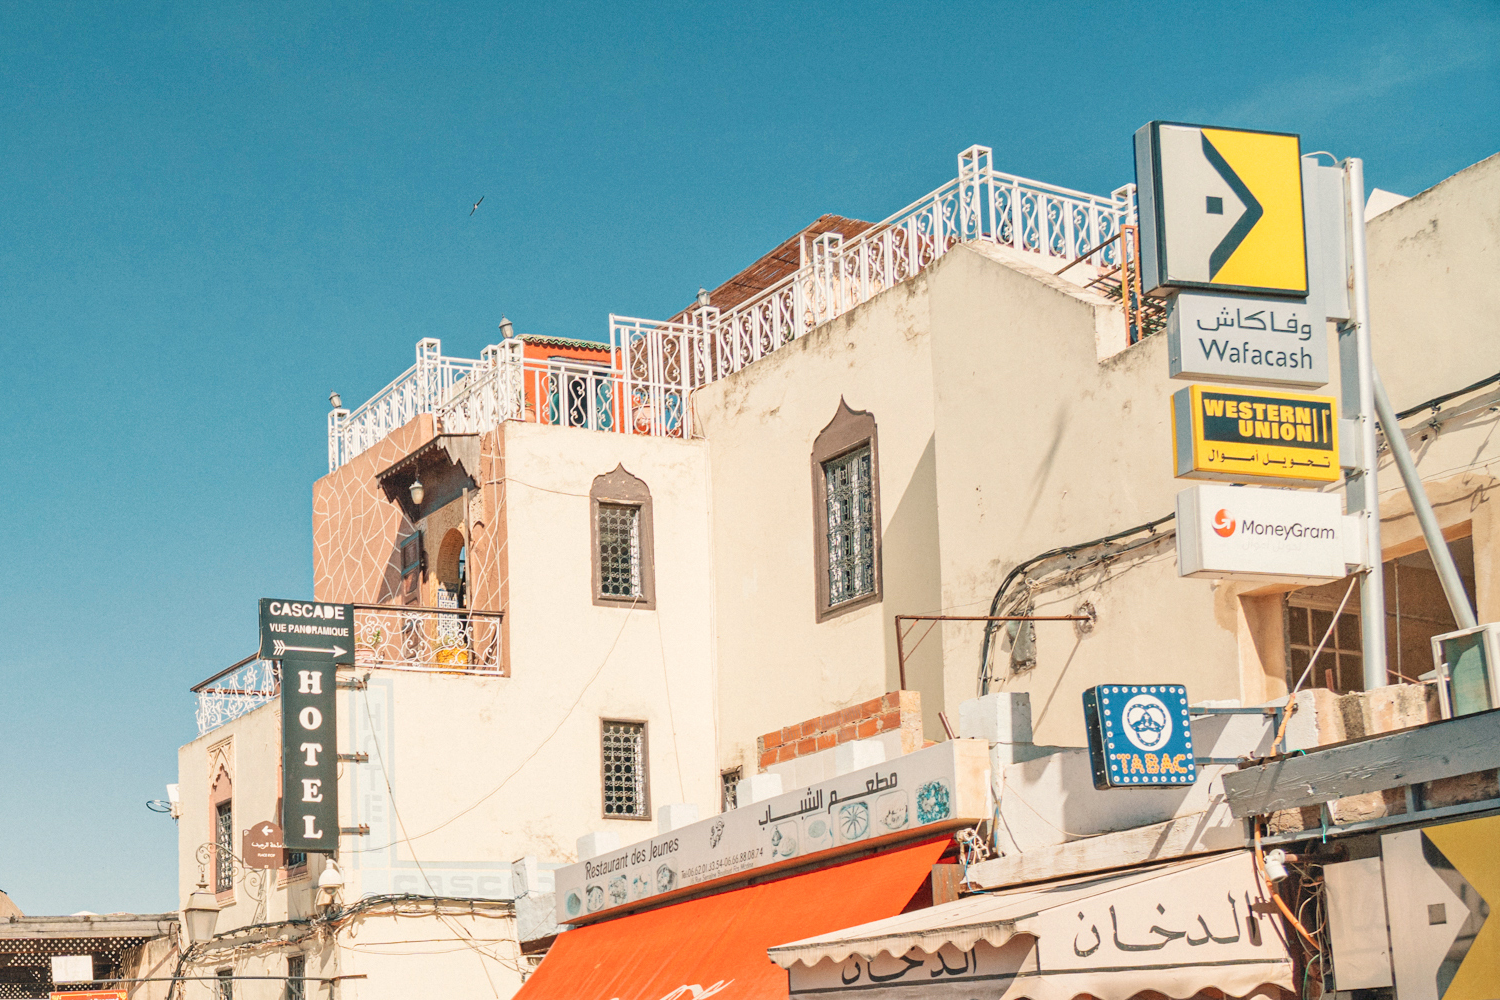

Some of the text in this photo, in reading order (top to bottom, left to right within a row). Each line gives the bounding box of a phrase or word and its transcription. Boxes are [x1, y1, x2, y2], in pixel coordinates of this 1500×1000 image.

[1196, 307, 1312, 341] وفاكاش
[1198, 338, 1313, 370] Wafacash
[1203, 398, 1313, 424] WESTERN
[1238, 419, 1313, 443] UNION
[1262, 450, 1331, 470] تحويل
[1241, 520, 1336, 541] MoneyGram
[269, 601, 345, 620] CASCADE
[269, 623, 349, 637] VUE PANORAMIQUE
[297, 670, 324, 840] HOTEL
[1115, 753, 1189, 775] TABAC
[758, 772, 897, 831] مطعم الشباب
[585, 837, 679, 880] Restaurant des Jeunes
[1073, 888, 1264, 959] الدخان
